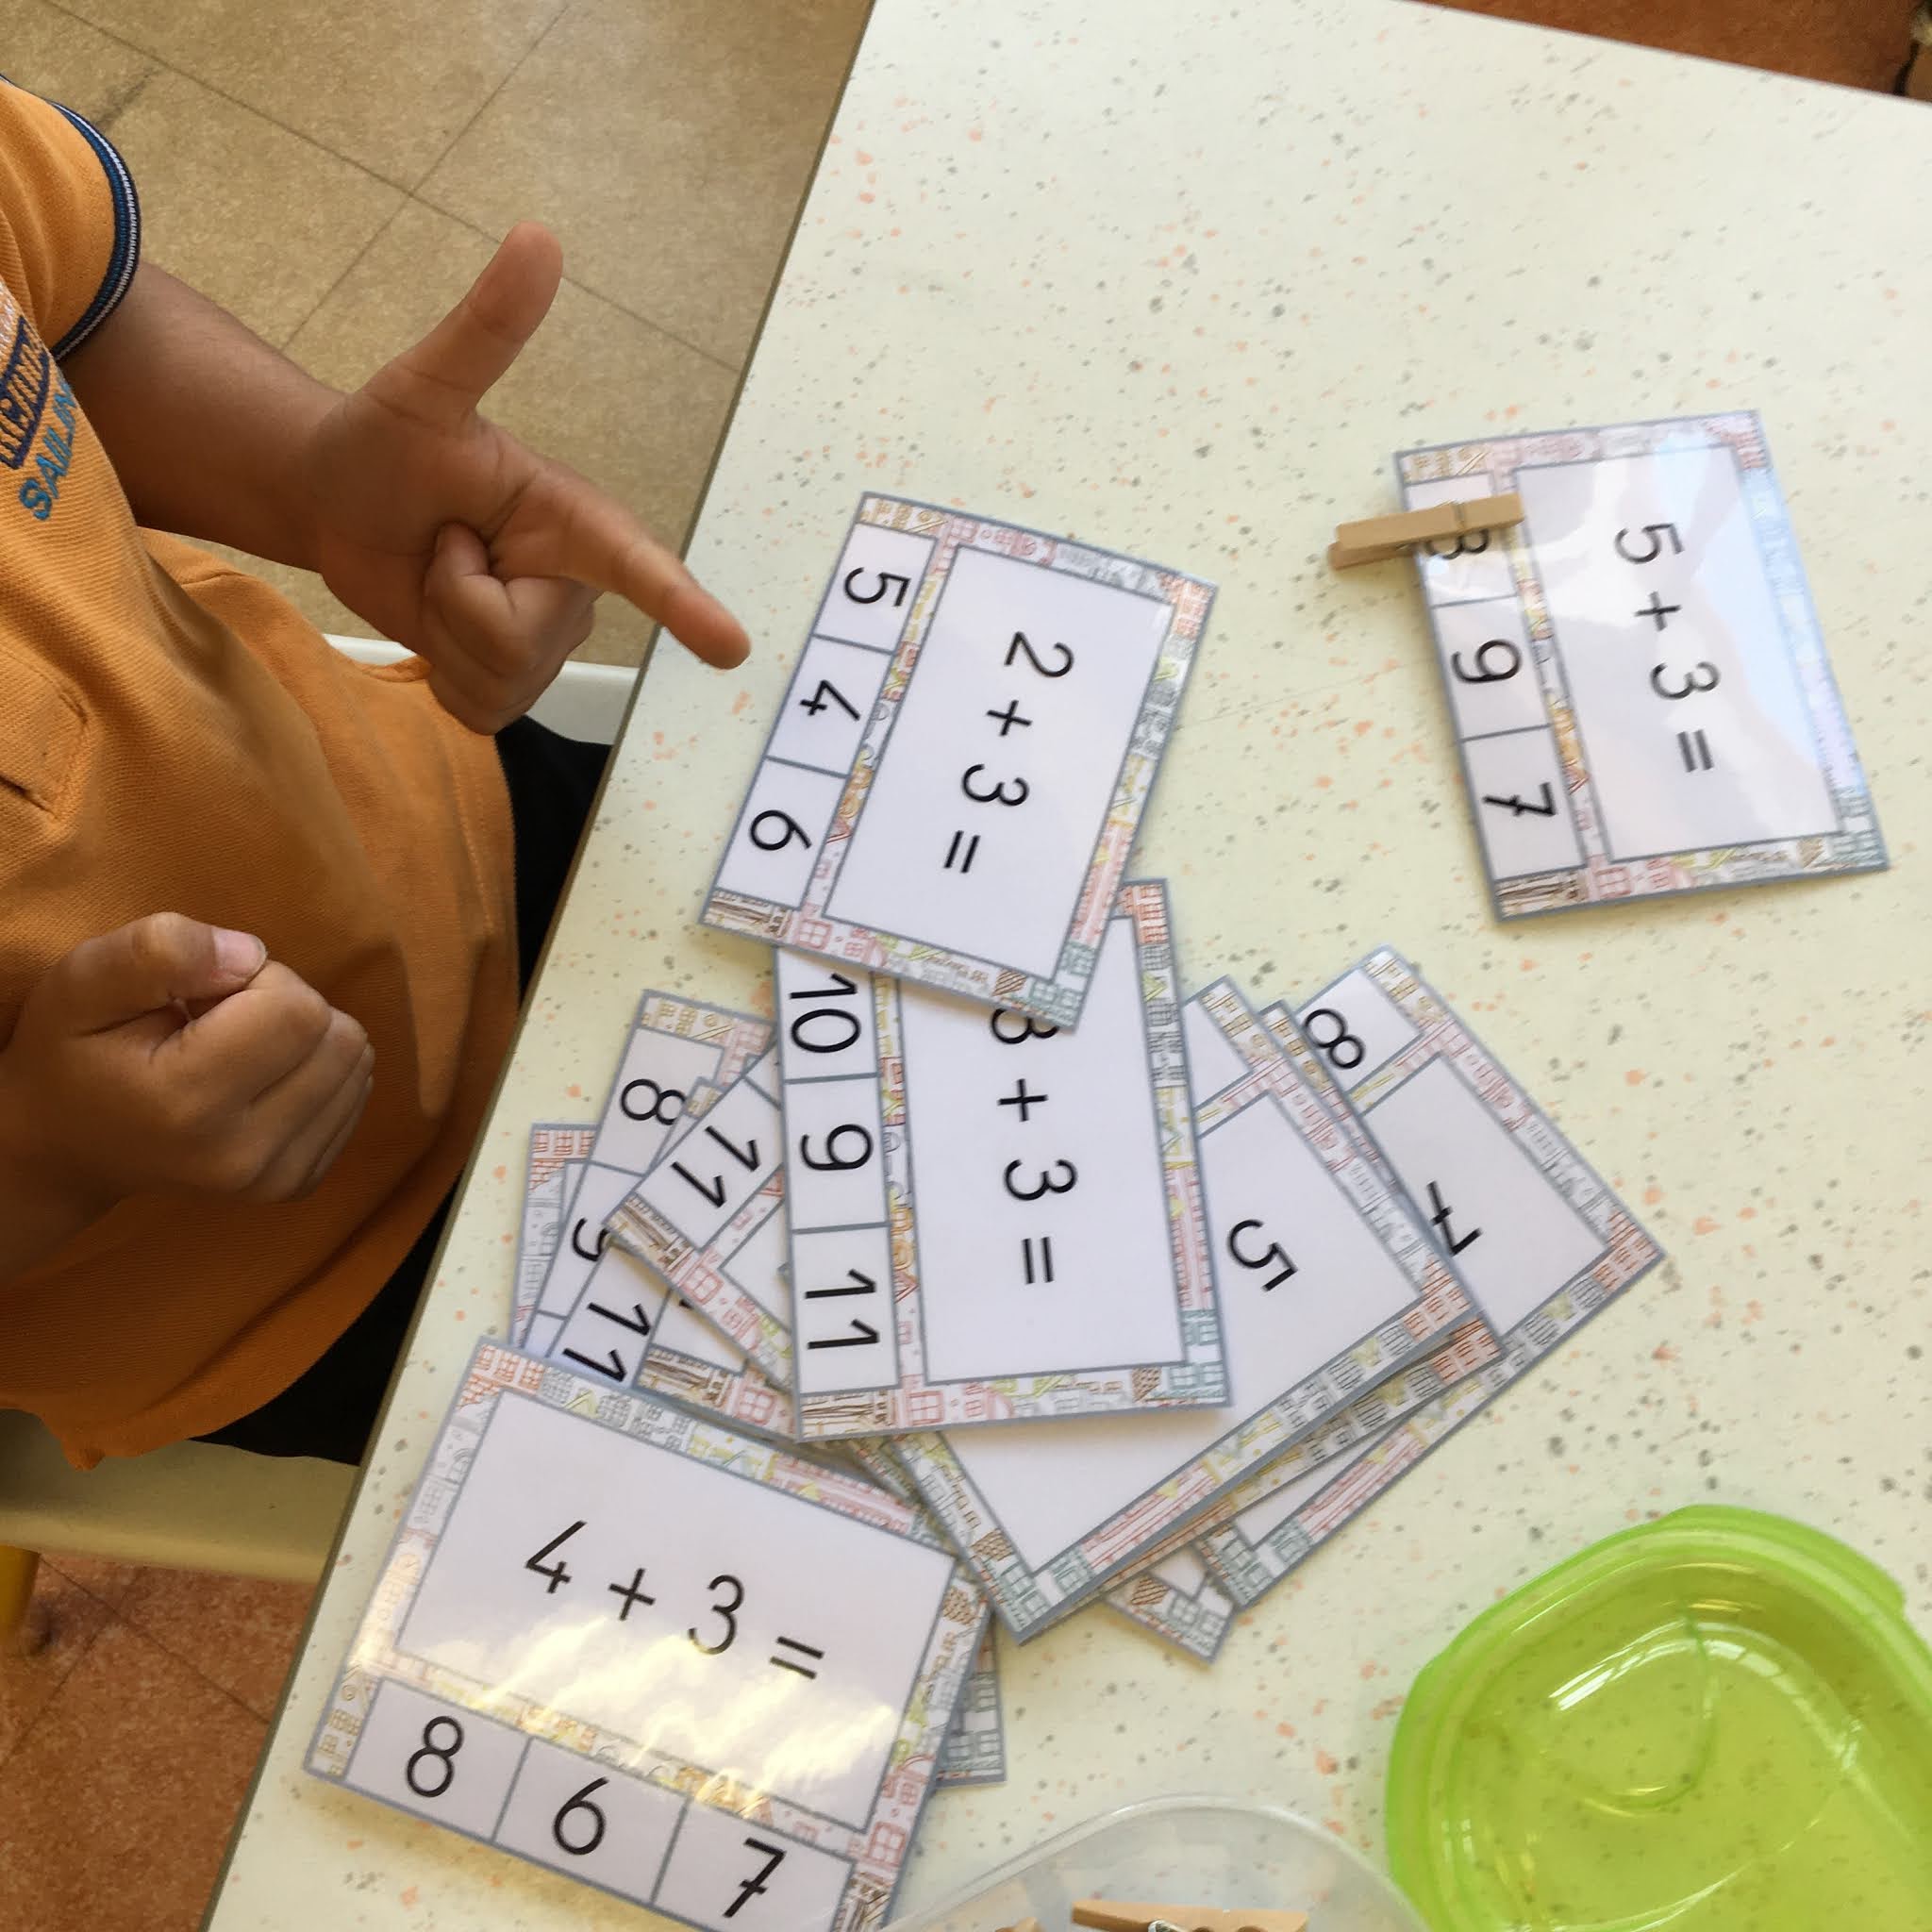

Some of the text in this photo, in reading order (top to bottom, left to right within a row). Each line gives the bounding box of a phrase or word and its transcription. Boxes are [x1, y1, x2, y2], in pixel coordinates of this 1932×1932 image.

[1451, 639, 1522, 685] 9
[1615, 521, 1721, 774] 5 + 3 =
[749, 566, 911, 852] 5 4 6
[942, 631, 1074, 874] 2 + 3 =
[1483, 782, 1557, 818] 7
[1302, 1008, 1366, 1071] 8
[620, 1077, 687, 1126] 8
[997, 1077, 1048, 1123] +
[669, 1124, 761, 1209] 11
[789, 973, 880, 1351] 10 9 11
[1004, 1158, 1077, 1202] 3
[1227, 1219, 1299, 1292] 5
[1426, 1179, 1484, 1257] 7
[1022, 1236, 1055, 1284] =
[561, 1301, 653, 1384] 11
[524, 1519, 825, 1680] 4 + 3 =
[405, 1715, 787, 1919] 8 6 7
